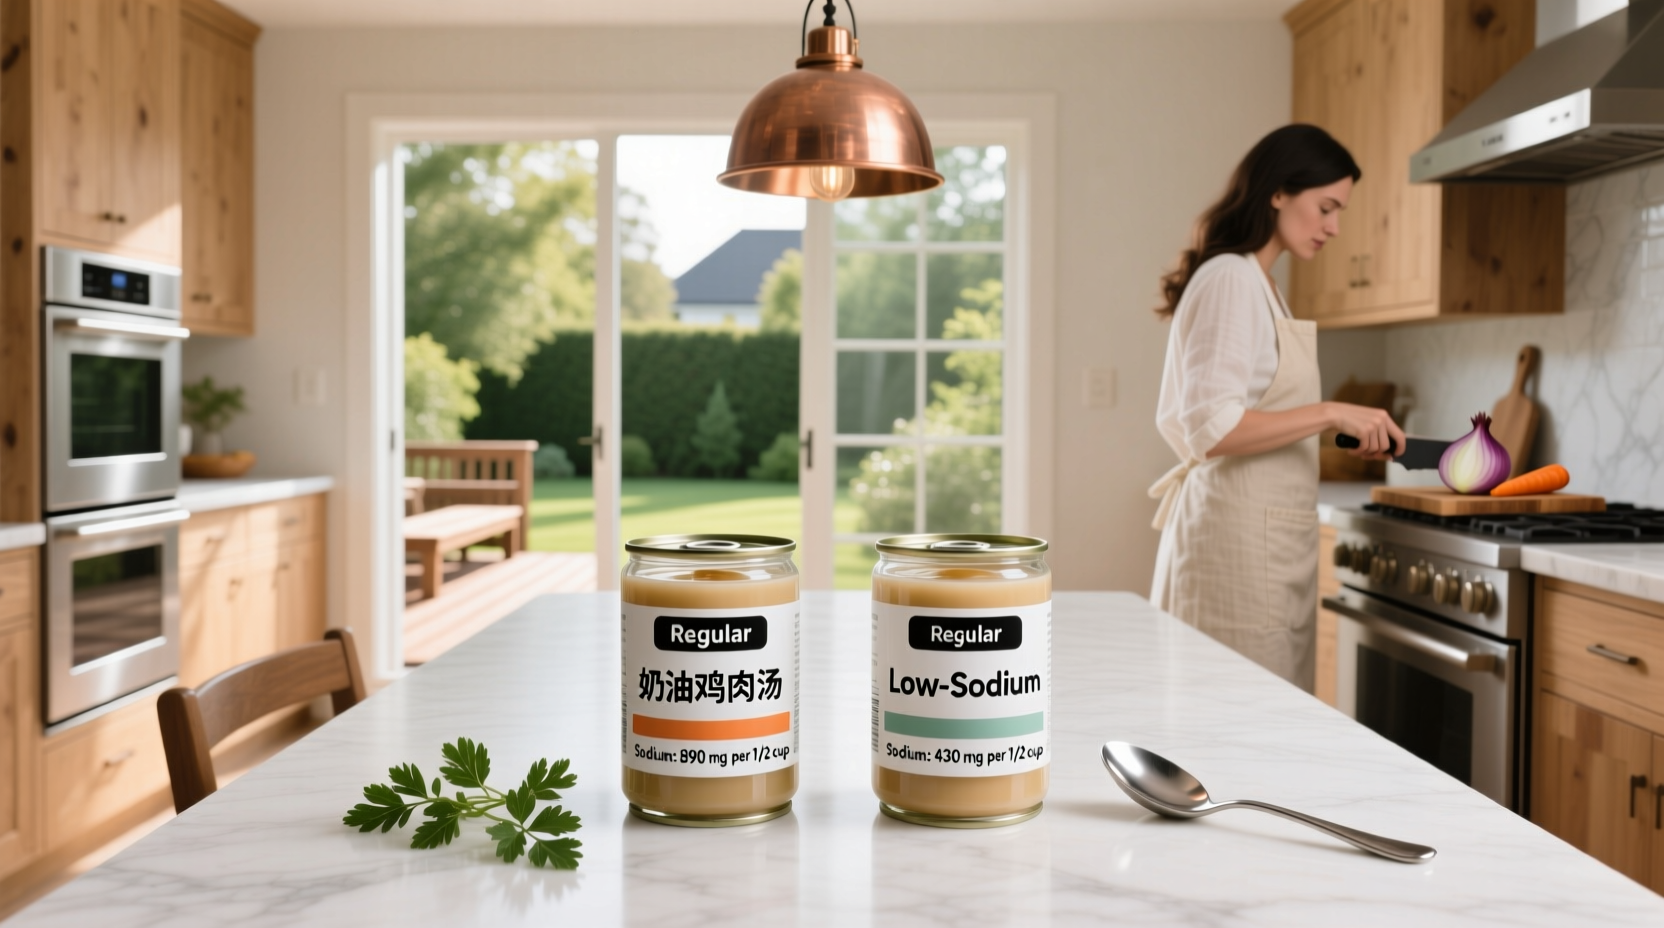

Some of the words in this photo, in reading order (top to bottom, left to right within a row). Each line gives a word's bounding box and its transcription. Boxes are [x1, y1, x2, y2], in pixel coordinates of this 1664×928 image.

[670, 623, 752, 649] Regular
[931, 624, 1002, 648] Regular
[638, 666, 783, 704] 奶油鸡肉汤
[889, 667, 1041, 698] Low-Sodium
[680, 749, 706, 764] 890
[709, 752, 728, 767] mg
[731, 750, 751, 766] per
[752, 744, 771, 763] 1/2
[772, 746, 790, 761] cup
[886, 742, 931, 762] Sodium:
[934, 748, 961, 764] 430
[963, 752, 983, 767] mg
[987, 750, 1007, 766] per
[1008, 745, 1025, 763] 1/2
